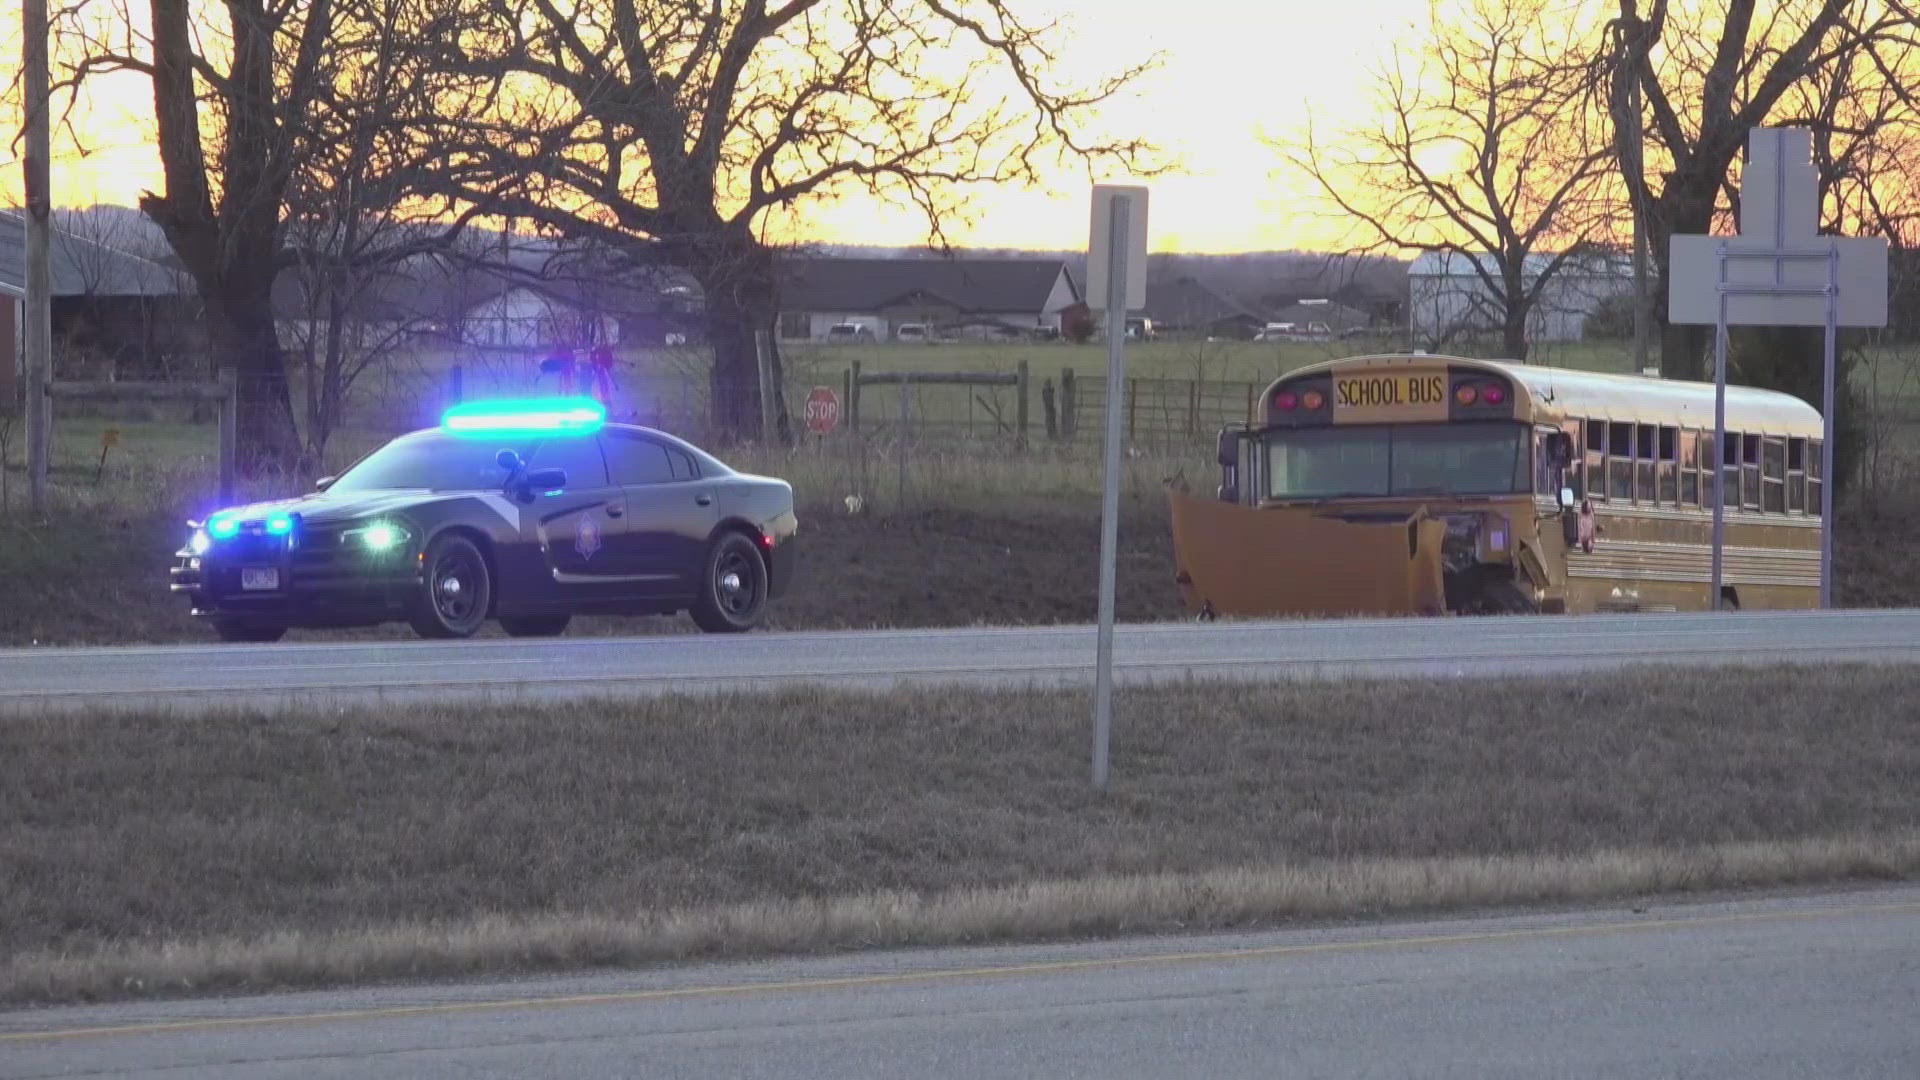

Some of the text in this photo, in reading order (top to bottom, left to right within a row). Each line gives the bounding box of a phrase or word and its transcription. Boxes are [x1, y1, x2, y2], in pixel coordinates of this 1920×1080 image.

[1338, 376, 1442, 406] SCHOOL BUS
[807, 400, 836, 419] STOP
